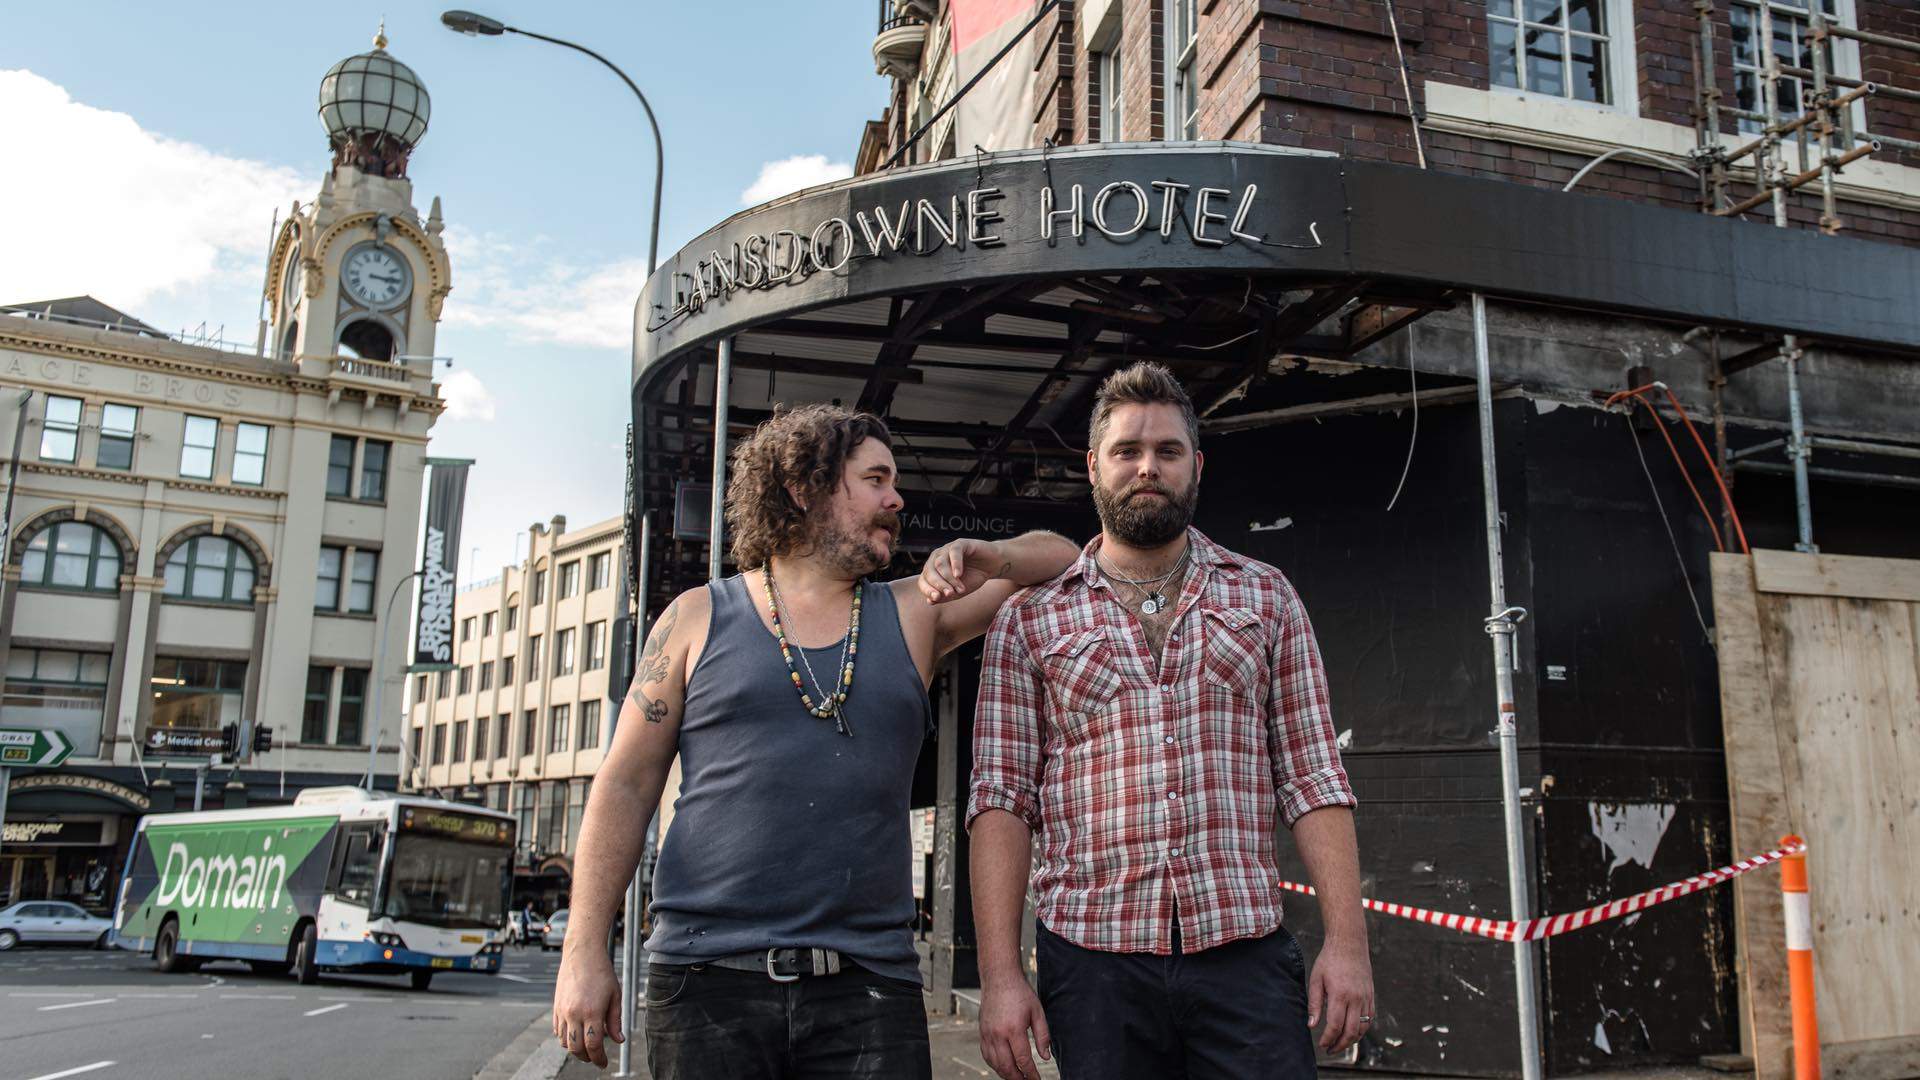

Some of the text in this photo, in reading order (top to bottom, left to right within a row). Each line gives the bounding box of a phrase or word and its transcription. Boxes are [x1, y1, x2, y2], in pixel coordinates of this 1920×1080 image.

[670, 180, 1262, 315] LANSDOWNE HOTEL
[133, 371, 243, 408] BROS
[940, 514, 1016, 534] LOUNGE
[418, 525, 444, 652] BROADWAY
[432, 572, 454, 662] SYDNEY
[167, 735, 203, 747] Medical
[472, 820, 497, 838] 370
[155, 835, 287, 909] Domain
